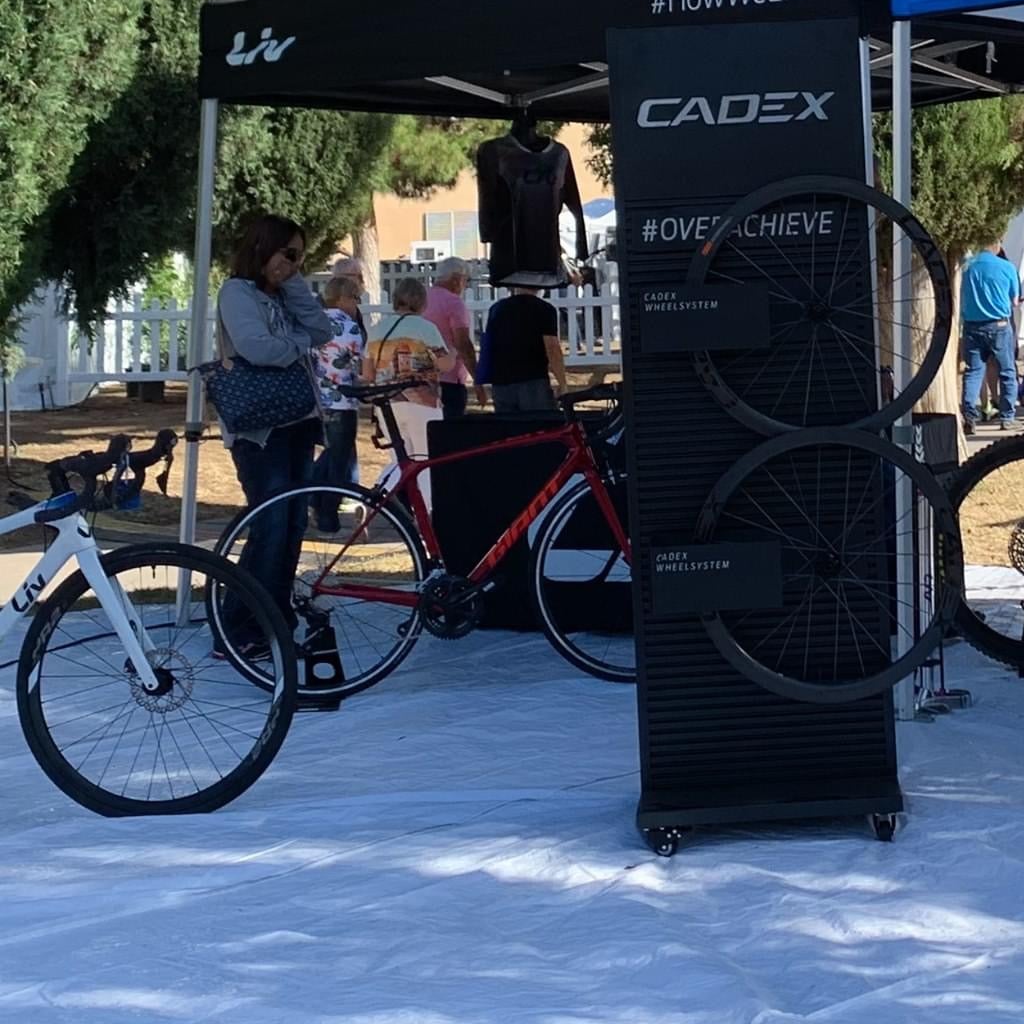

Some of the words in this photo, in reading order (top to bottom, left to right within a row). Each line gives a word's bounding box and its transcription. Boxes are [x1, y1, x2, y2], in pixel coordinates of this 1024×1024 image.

[226, 27, 296, 66] Liv
[636, 91, 835, 128] CADEX
[641, 210, 834, 244] #OVEACHIEVE
[644, 292, 677, 301] CADEX
[644, 301, 719, 312] WHEELSYSTEM
[656, 552, 688, 563] CADEX
[656, 559, 731, 572] WHEELSYSTEM
[11, 573, 46, 613] Liv
